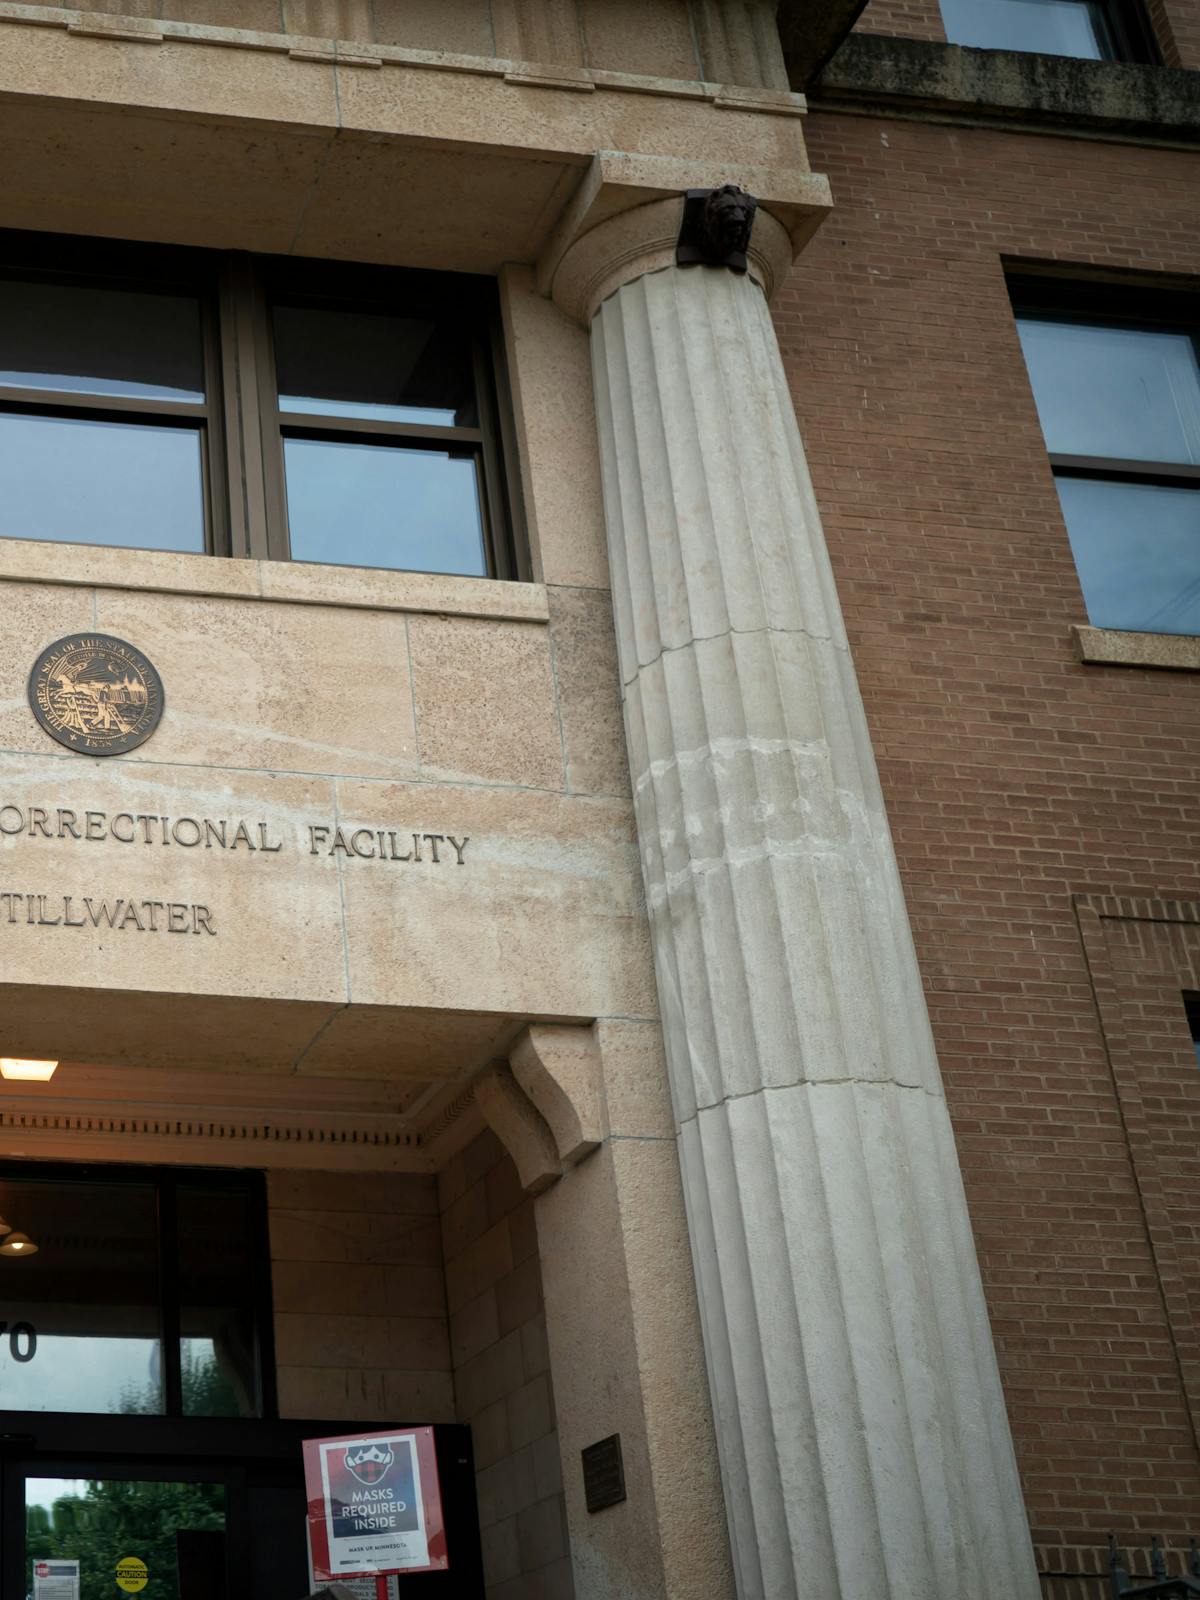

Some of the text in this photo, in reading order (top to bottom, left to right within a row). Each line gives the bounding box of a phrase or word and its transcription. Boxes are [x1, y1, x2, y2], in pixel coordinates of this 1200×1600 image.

[41, 650, 62, 673] SEAL
[36, 678, 50, 711] GREAT
[309, 825, 470, 864] FACILITY
[352, 1488, 394, 1503] MASKS
[341, 1501, 407, 1517] REQUIRED
[354, 1516, 397, 1530] INSIDE
